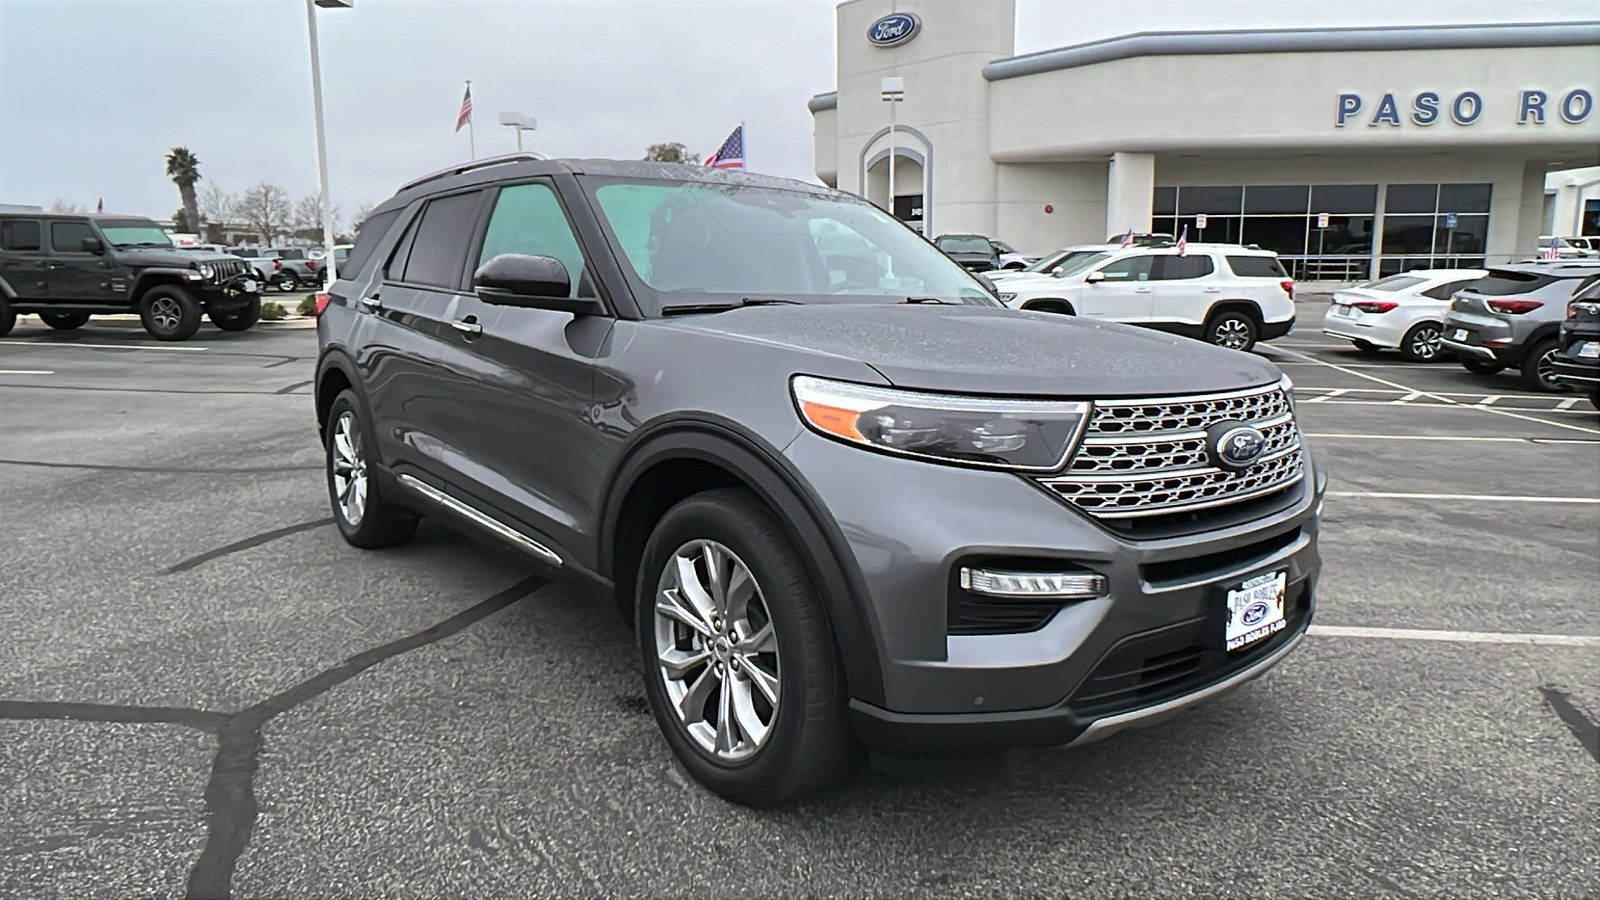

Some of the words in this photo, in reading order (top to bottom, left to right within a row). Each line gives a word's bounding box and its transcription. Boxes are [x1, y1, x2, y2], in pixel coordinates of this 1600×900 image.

[875, 18, 905, 40] Ford
[1335, 91, 1484, 127] PASO
[1516, 88, 1594, 125] RO
